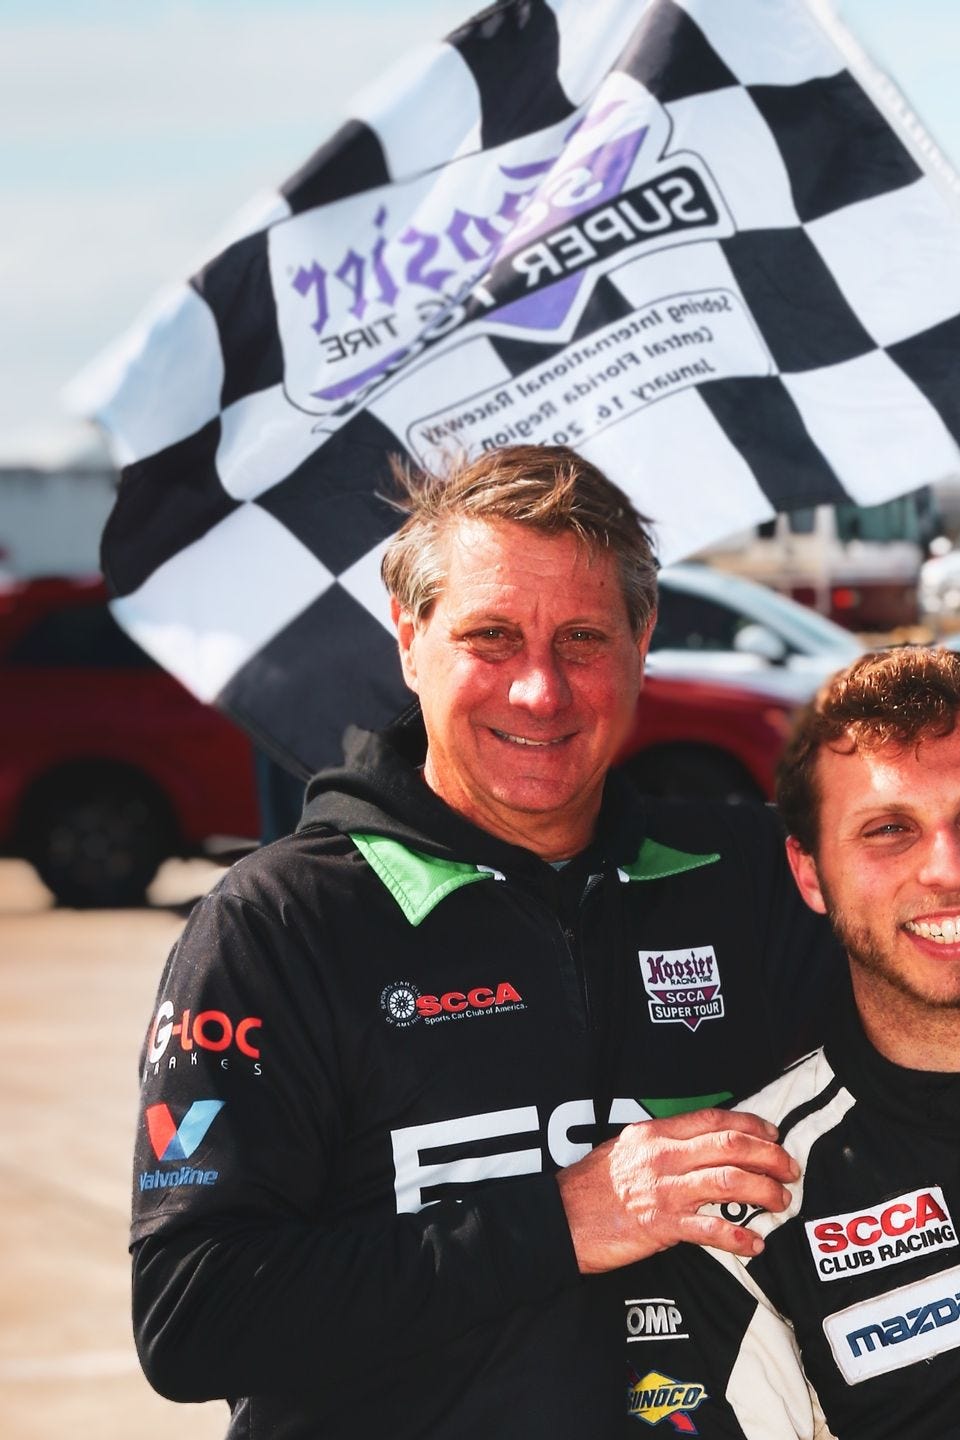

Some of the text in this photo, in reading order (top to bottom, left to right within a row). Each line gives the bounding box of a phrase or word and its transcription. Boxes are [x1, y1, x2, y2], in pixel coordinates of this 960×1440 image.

[647, 950, 713, 984] Hoosier
[411, 985, 421, 998] CLU
[416, 982, 522, 1016] SCCA
[666, 990, 705, 1003] SCCA
[425, 1015, 451, 1025] Sports
[466, 1009, 484, 1018] Club
[486, 1007, 494, 1015] of
[655, 1002, 719, 1018] SUPER TOUR
[139, 1166, 219, 1192] Valvoline
[814, 1193, 948, 1254] SCCA
[818, 1225, 955, 1275] CLUB RACING
[626, 1305, 683, 1335] OMP
